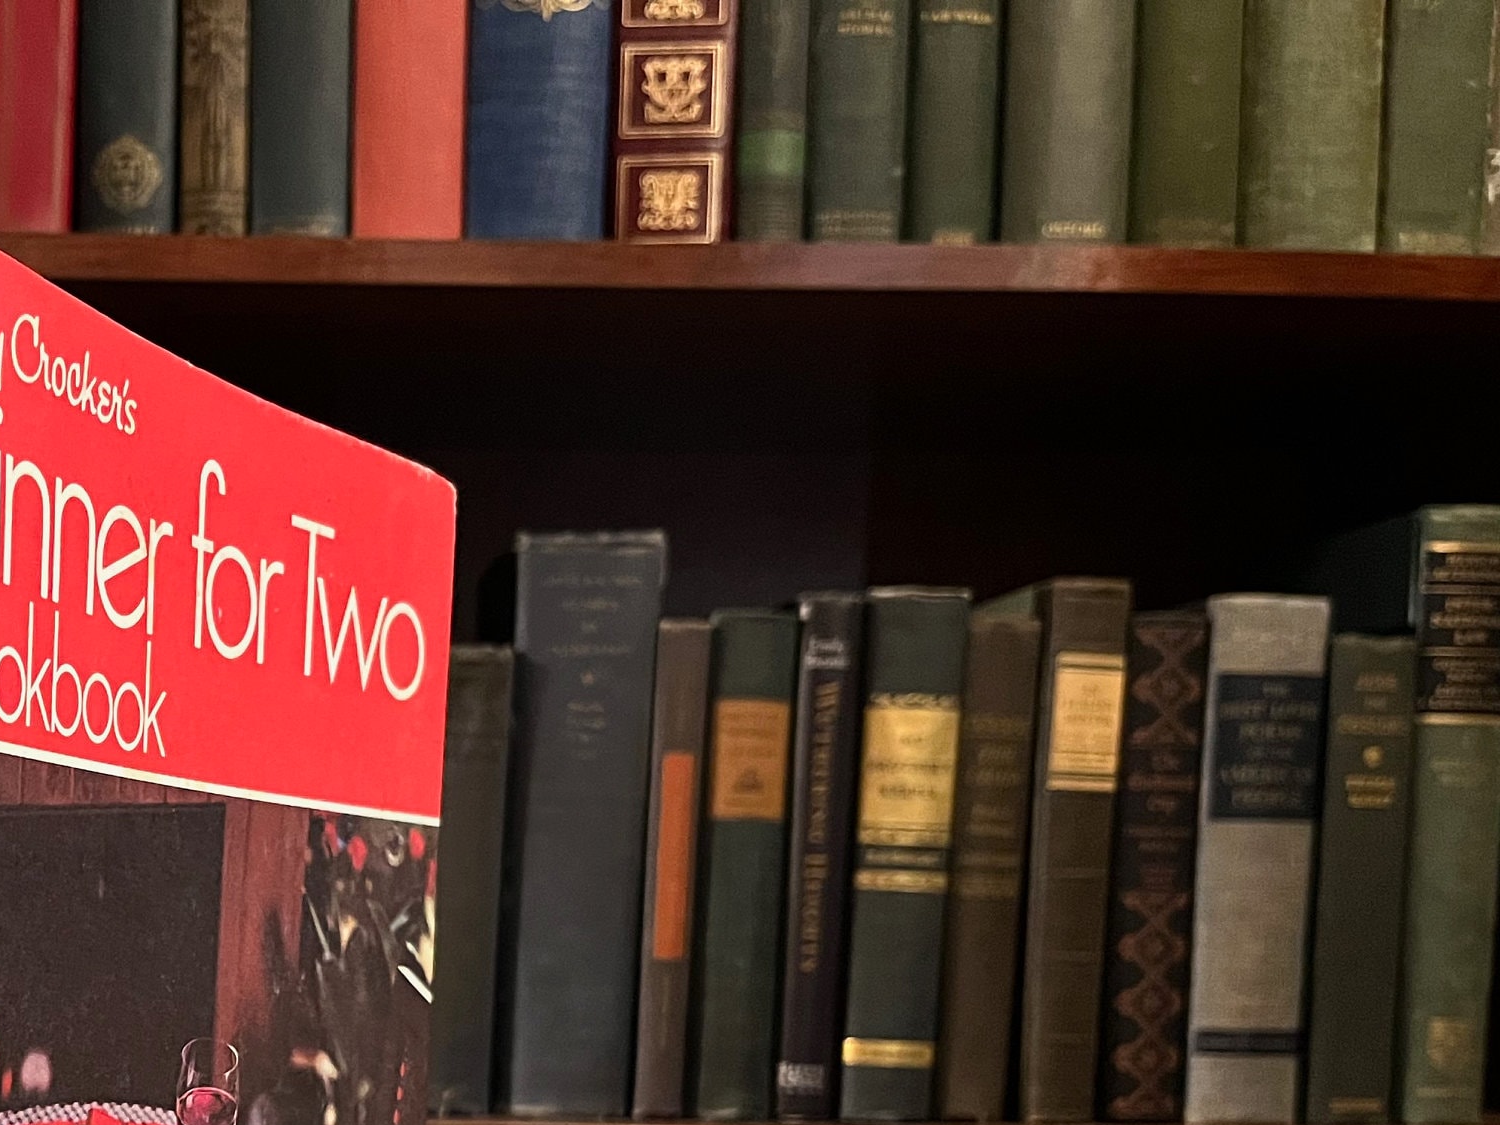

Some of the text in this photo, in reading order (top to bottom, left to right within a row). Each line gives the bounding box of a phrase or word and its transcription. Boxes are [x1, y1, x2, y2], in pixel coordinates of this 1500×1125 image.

[10, 313, 137, 436] Crocker's
[191, 459, 285, 665] for
[290, 514, 426, 701] Two
